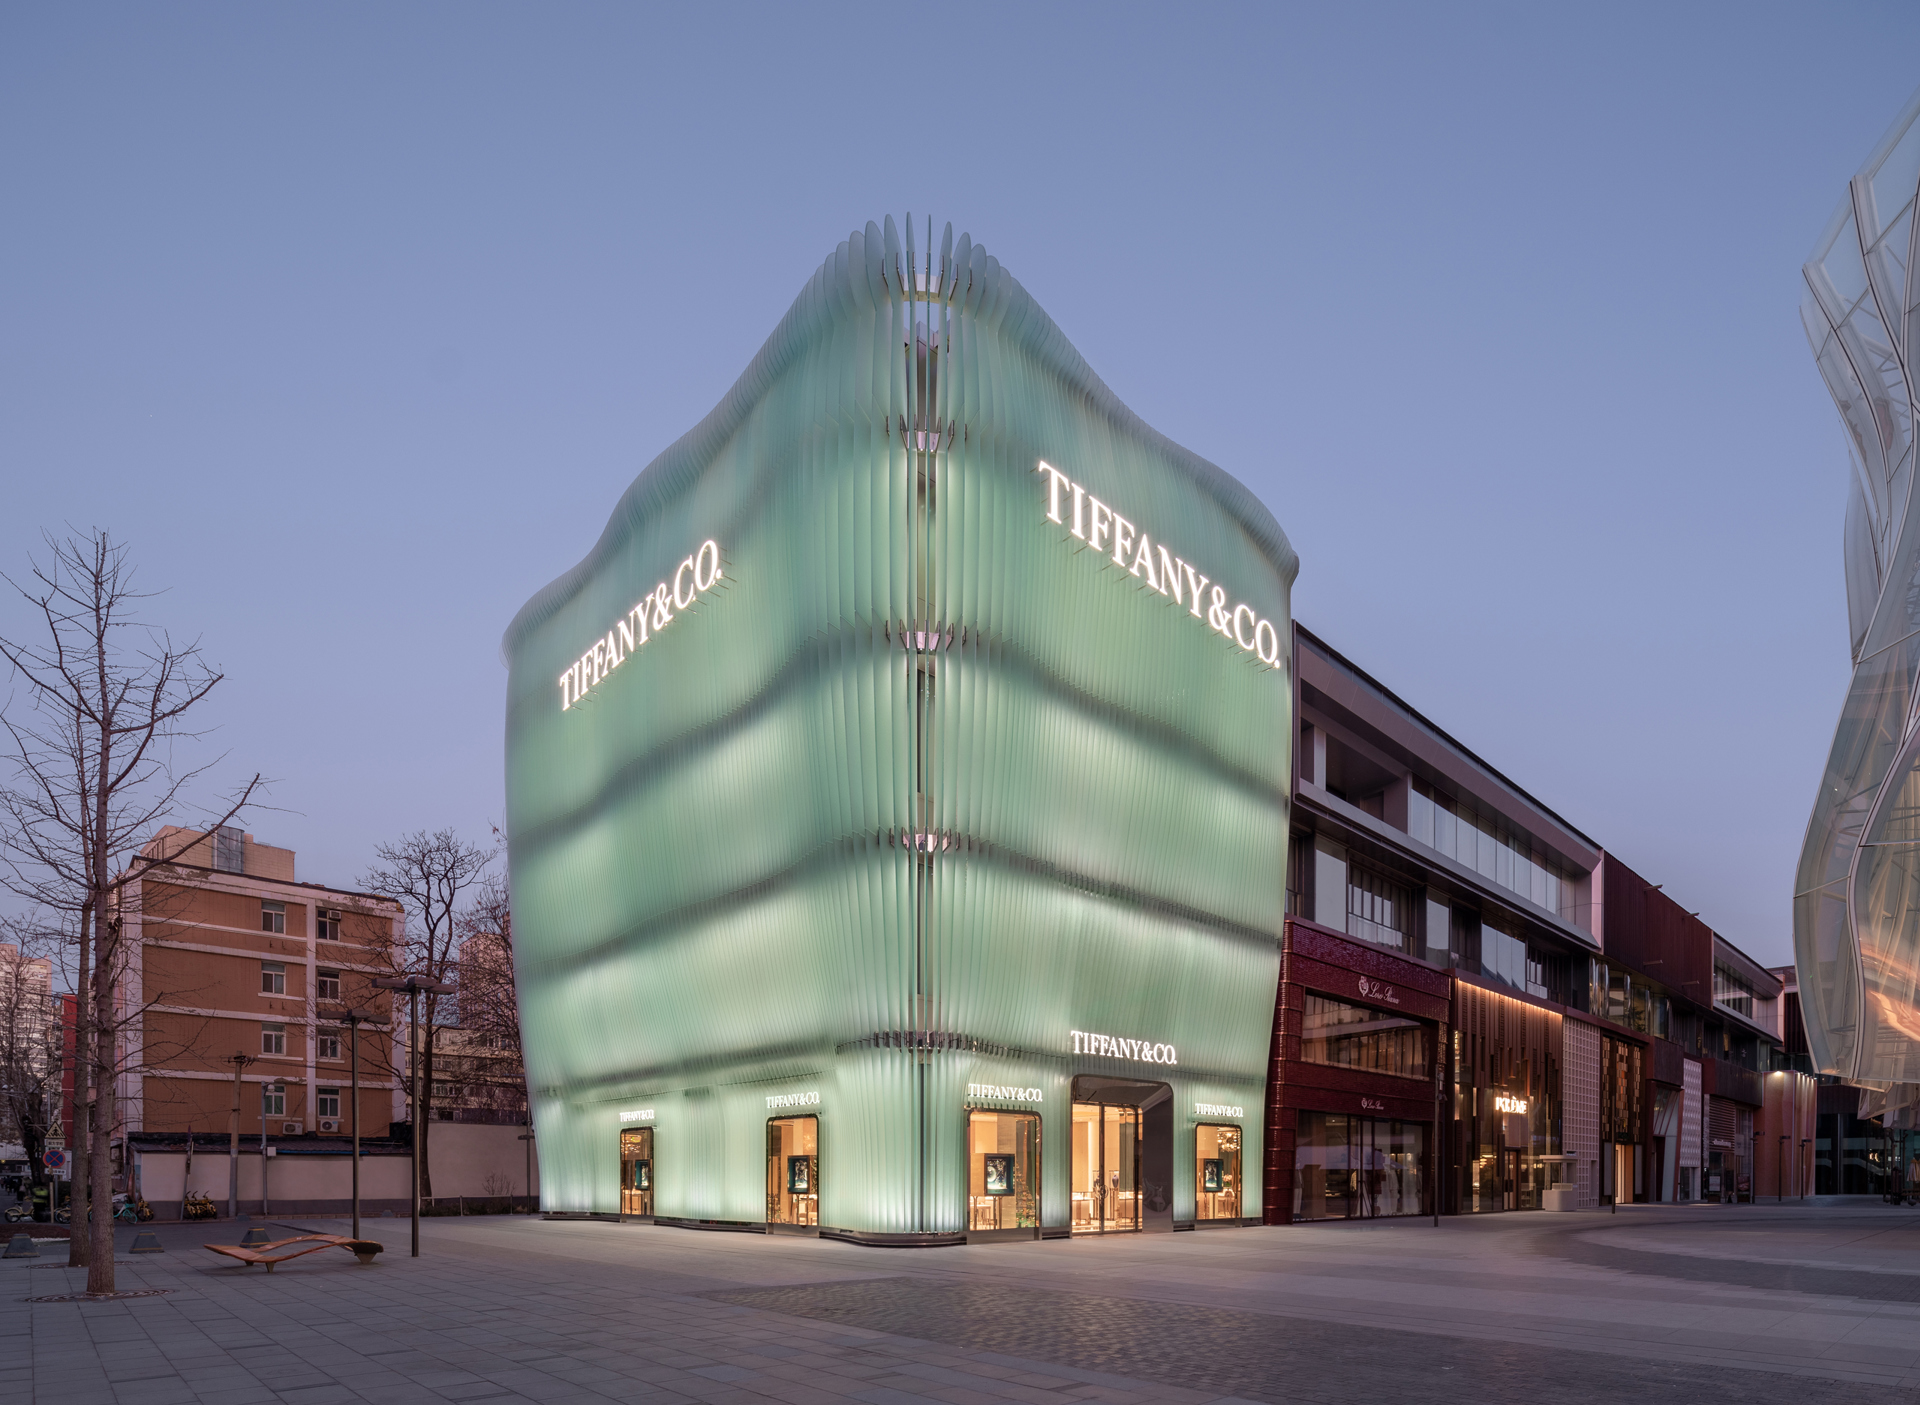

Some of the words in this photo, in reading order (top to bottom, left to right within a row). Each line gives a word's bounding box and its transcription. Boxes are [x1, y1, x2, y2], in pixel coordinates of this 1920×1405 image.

[1038, 460, 1280, 669] TIFFANY&CO.
[559, 540, 722, 711] TIFFANY&CO.
[1070, 1030, 1178, 1065] TIFFANY&CO.
[765, 1091, 820, 1109] TIFFANY&CO.
[967, 1083, 1043, 1102] TIFFANY&CO.
[1195, 1103, 1244, 1117] TIFFANY&CO.
